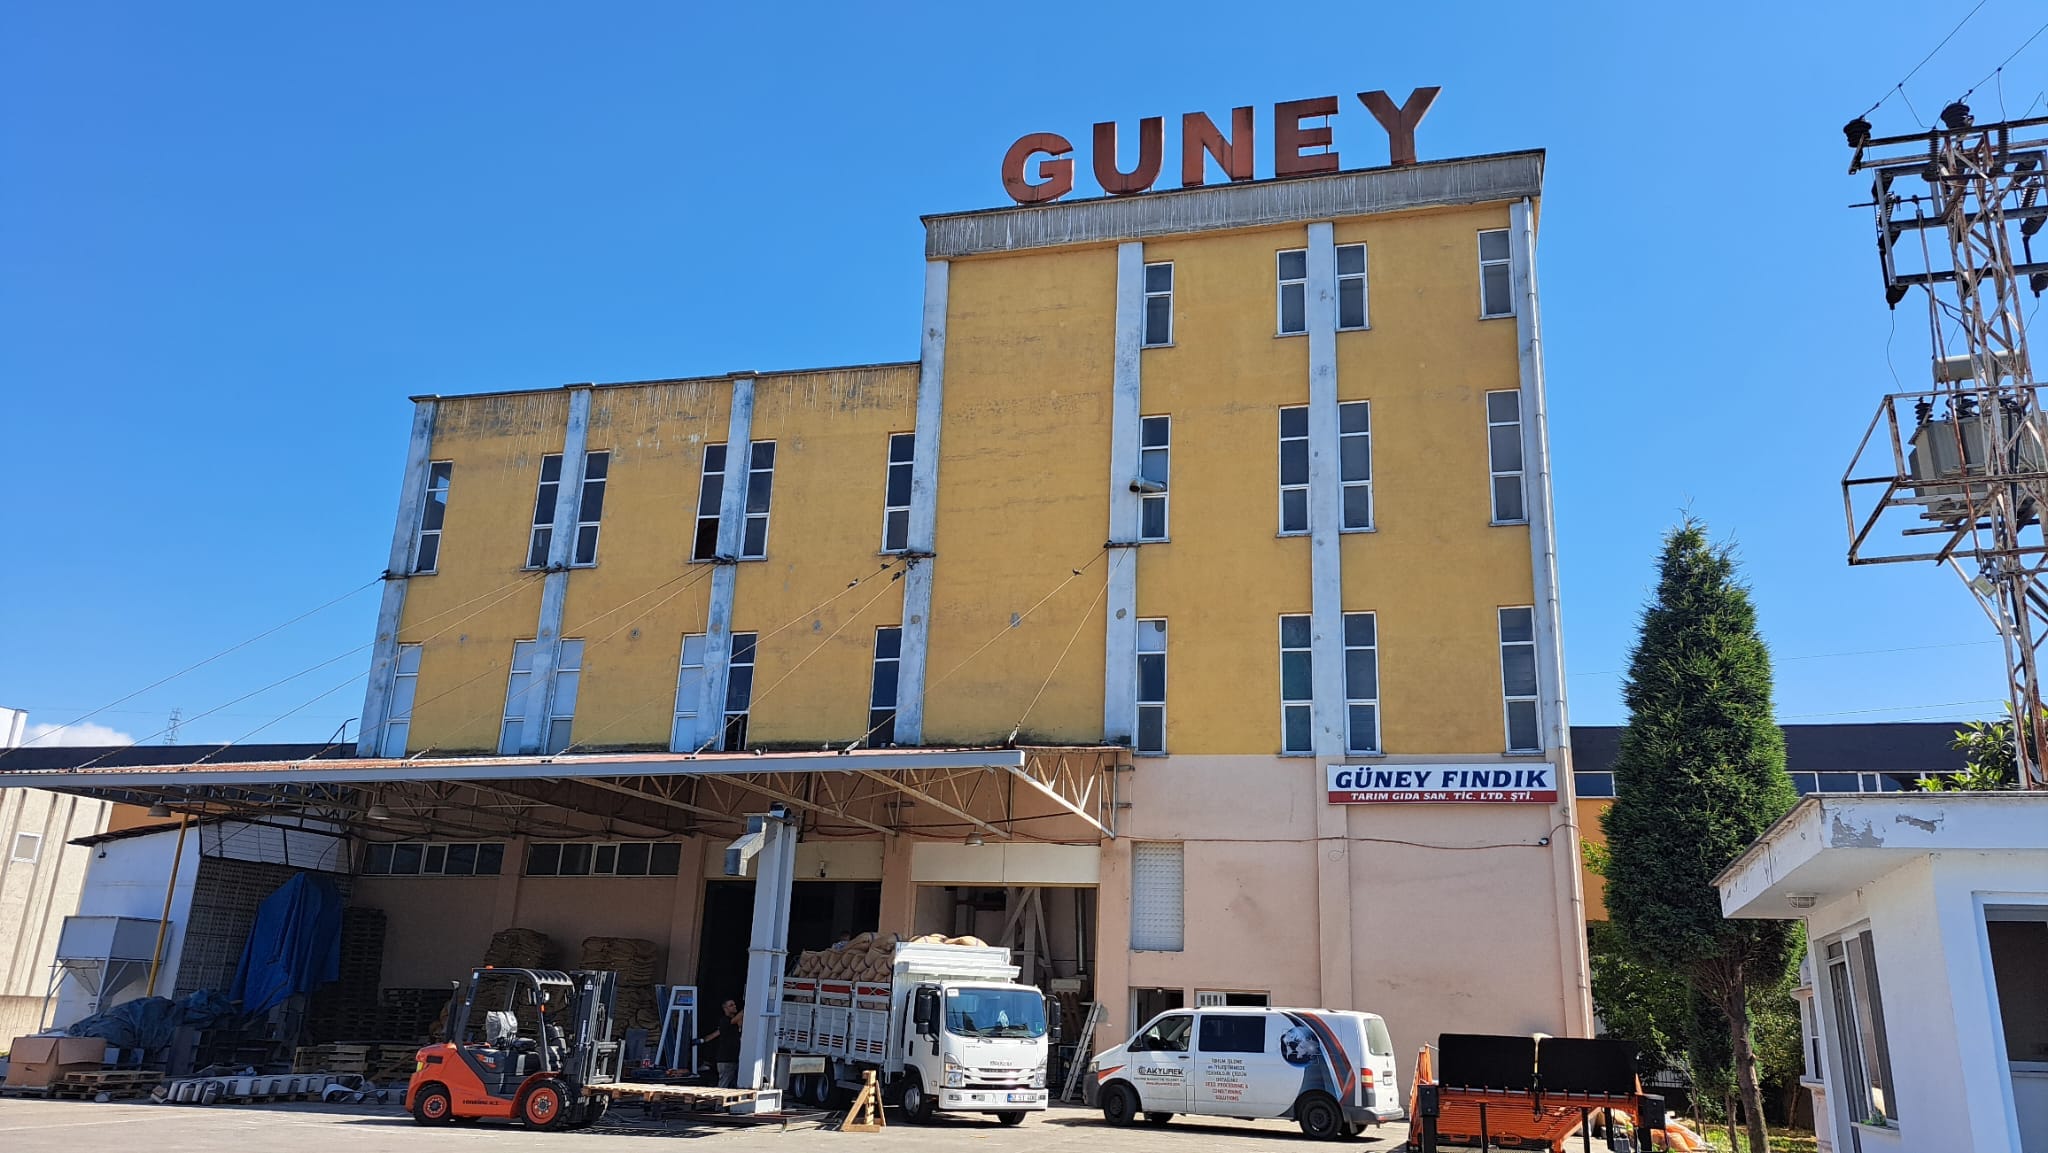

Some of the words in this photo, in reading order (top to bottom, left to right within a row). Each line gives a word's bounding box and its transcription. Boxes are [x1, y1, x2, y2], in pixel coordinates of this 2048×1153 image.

[1001, 86, 1442, 205] GUNEY
[1335, 767, 1432, 789] GÜNEY
[1441, 770, 1548, 788] FINDIK
[1351, 792, 1389, 800] TARIM
[1392, 792, 1420, 800] GIDA
[1423, 792, 1449, 800] SAN.
[1453, 791, 1476, 800] TİC.
[1480, 792, 1507, 800] LTD.
[1510, 791, 1534, 802] ŞTİ.
